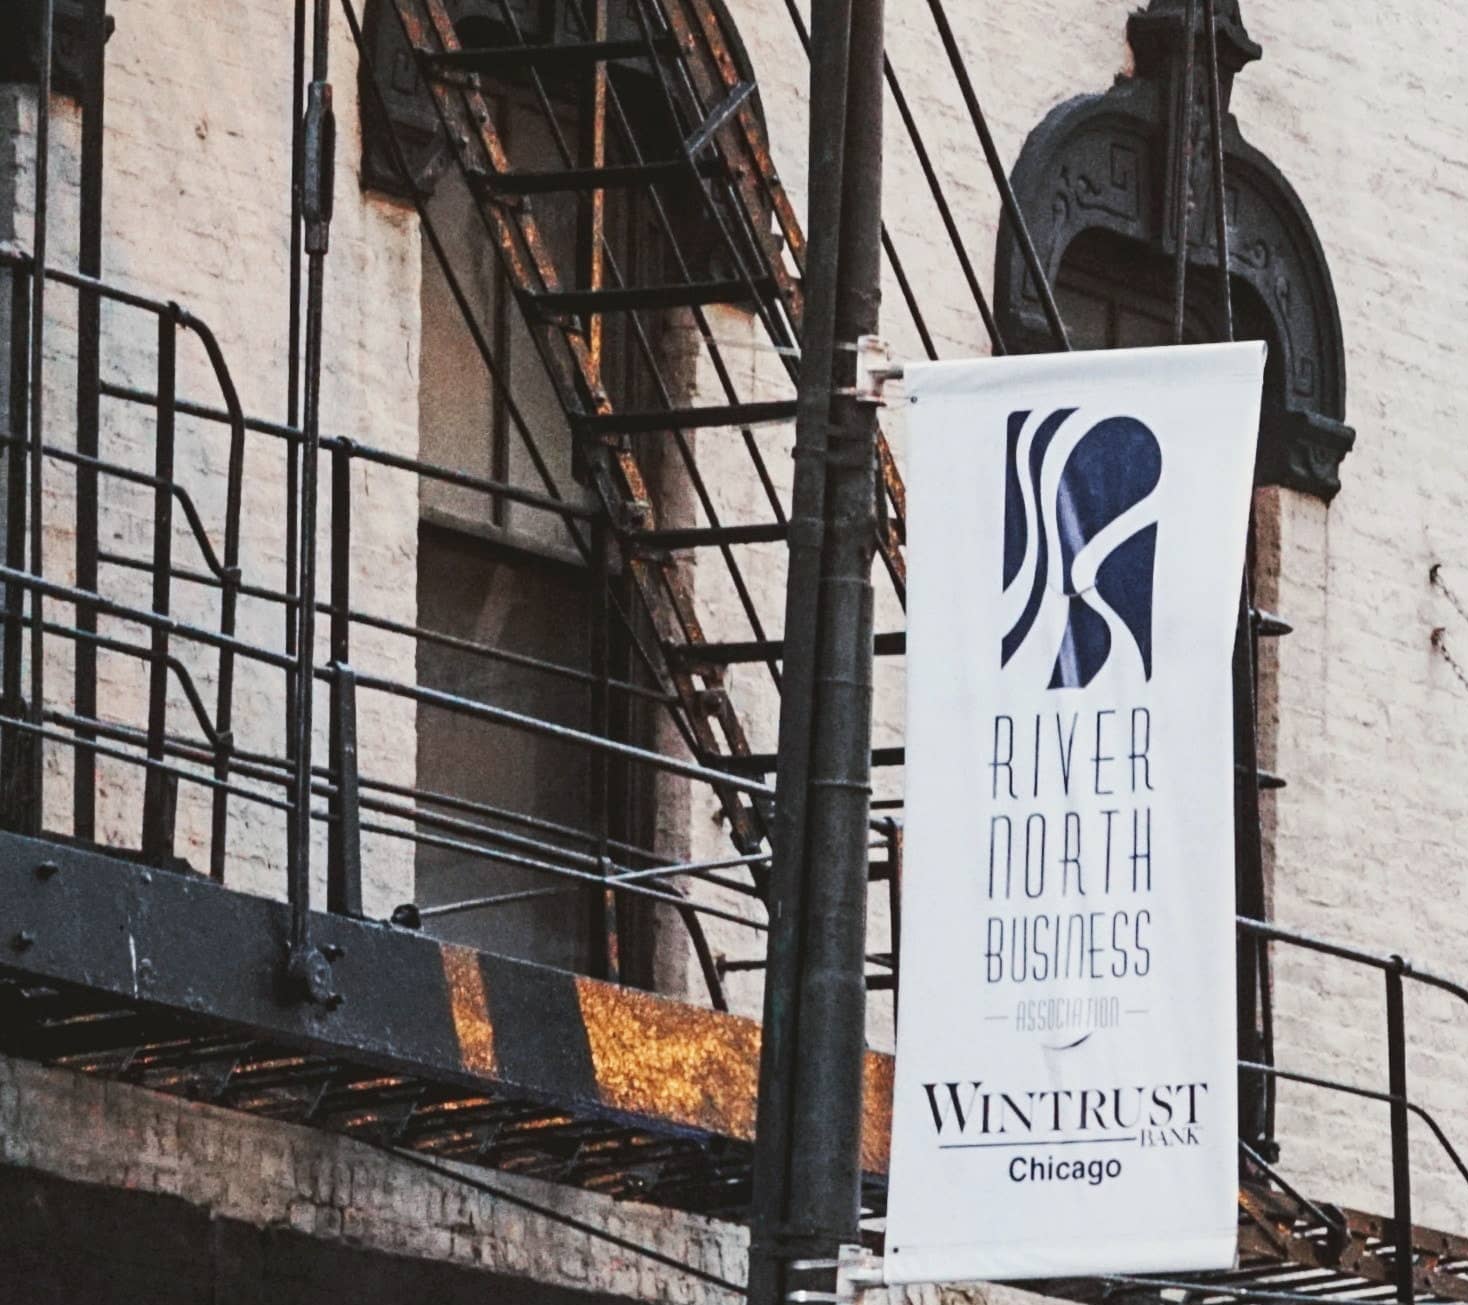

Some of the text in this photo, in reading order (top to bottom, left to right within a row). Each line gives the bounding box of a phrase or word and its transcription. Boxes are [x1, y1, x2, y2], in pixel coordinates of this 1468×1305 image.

[989, 706, 1155, 802] RIVER
[987, 807, 1154, 902] NORTH
[984, 909, 1152, 985] BUSINESS
[1015, 997, 1120, 1033] ASSOCIATION
[921, 1080, 1209, 1136] WINTRUST
[1140, 1127, 1202, 1148] BANK
[1008, 1155, 1123, 1186] Chicago
